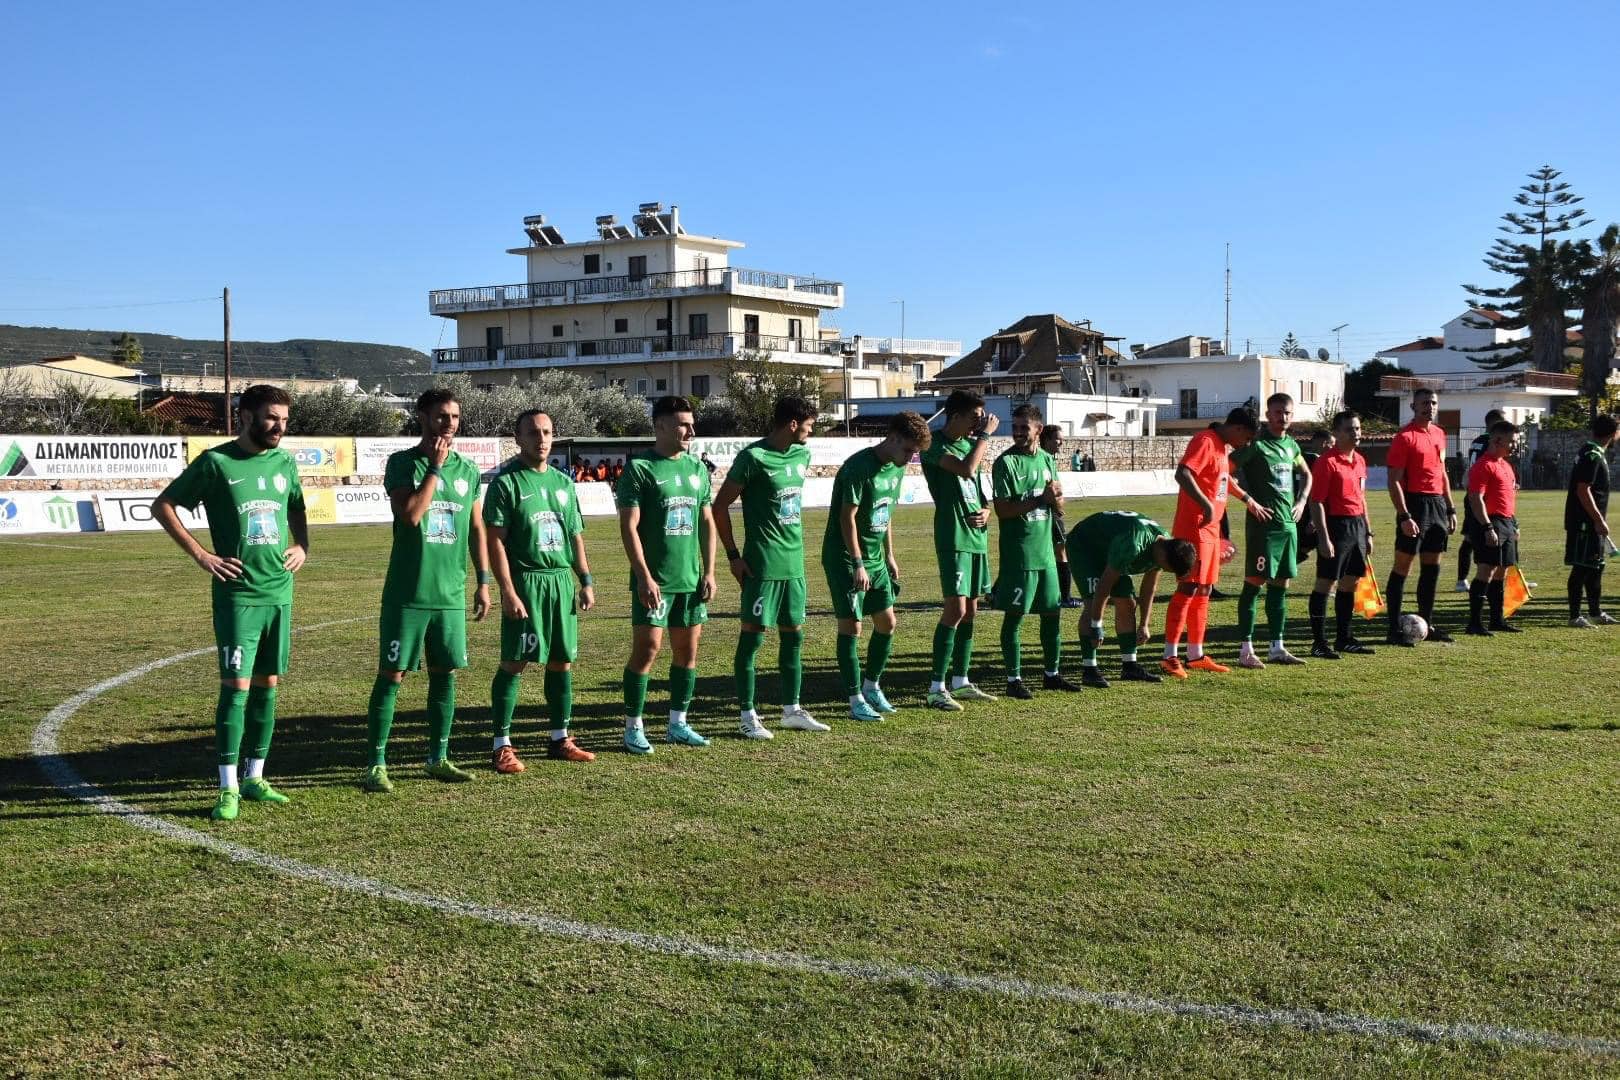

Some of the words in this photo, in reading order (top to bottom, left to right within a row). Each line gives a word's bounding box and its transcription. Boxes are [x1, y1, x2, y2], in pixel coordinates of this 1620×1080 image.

[35, 442, 178, 459] ΔΙΑΜΑΝΤΟΠΟΥΛΟΣ
[46, 463, 103, 474] ΜΕΤΑΛΛΙΚΑ
[107, 463, 168, 474] ΘΕΡΜΟΚΗΠΙΑ
[336, 492, 380, 503] COMPO
[1256, 556, 1266, 572] 8
[1012, 587, 1023, 606] 2
[752, 596, 764, 617] 6
[387, 639, 400, 663] 3
[520, 632, 538, 654] 19
[223, 645, 243, 670] 14
